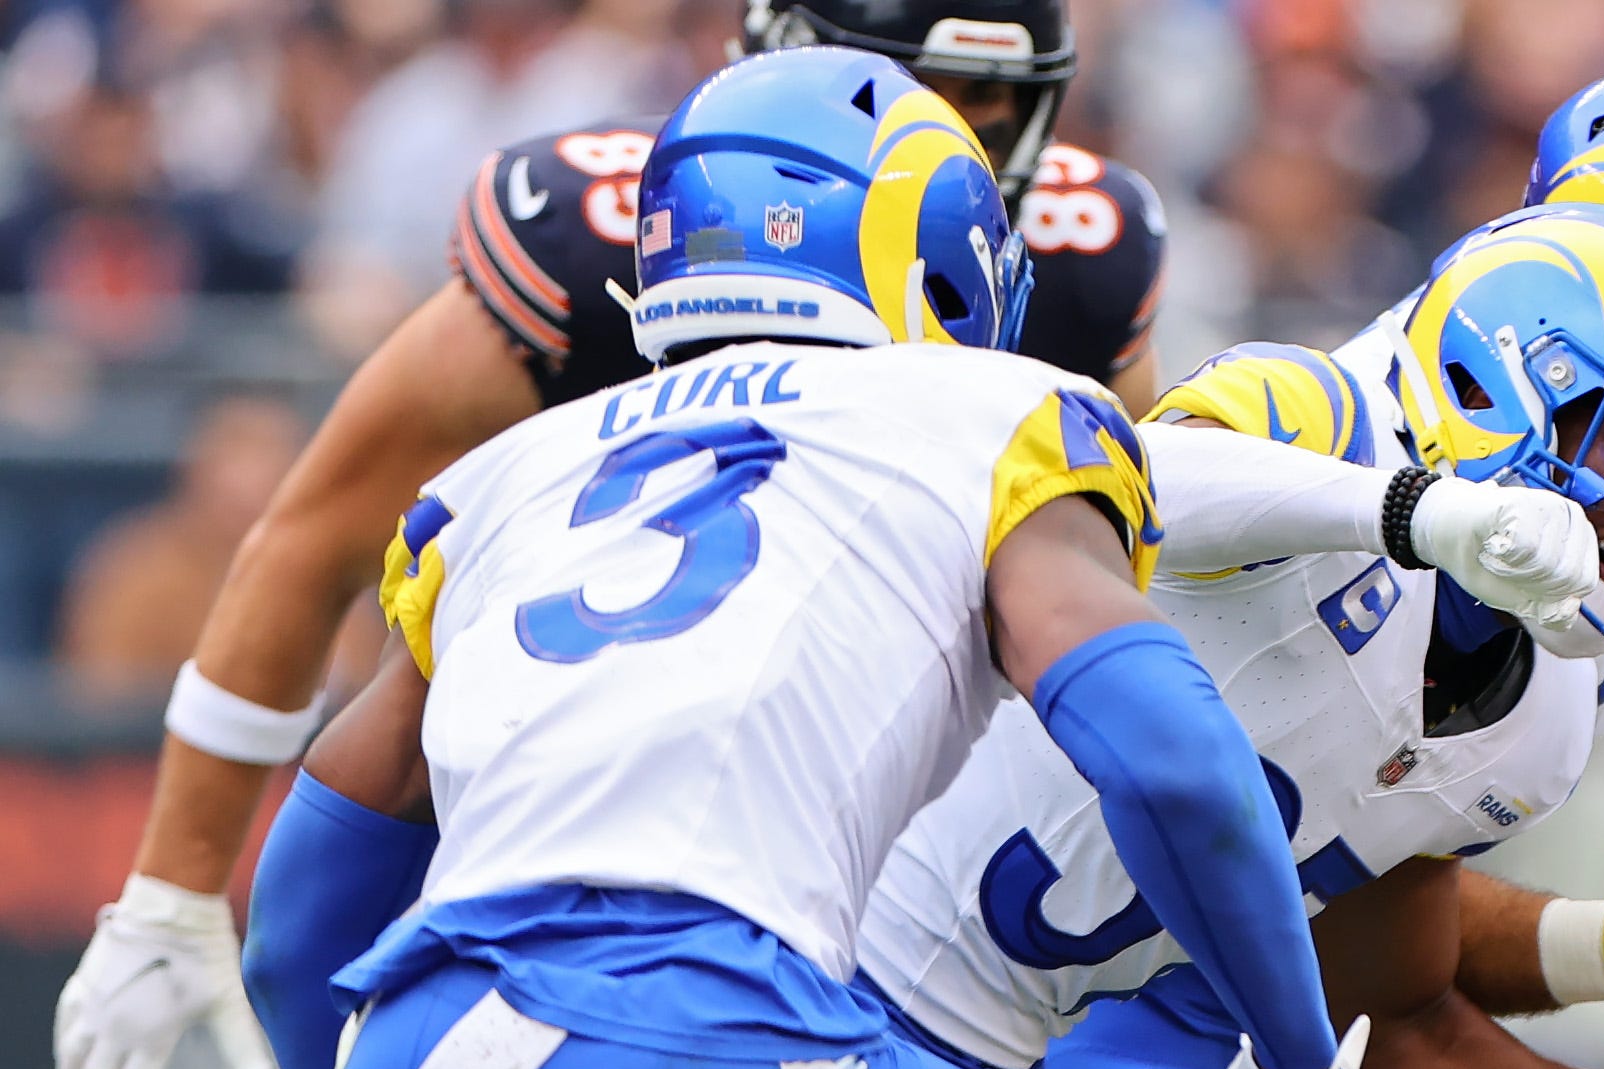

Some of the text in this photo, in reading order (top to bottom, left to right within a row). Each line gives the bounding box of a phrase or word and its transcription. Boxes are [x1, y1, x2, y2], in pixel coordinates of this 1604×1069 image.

[770, 221, 797, 248] NFL
[635, 298, 819, 325] LOS ANGELES
[598, 359, 801, 439] CURL
[514, 417, 787, 664] 3
[1342, 566, 1395, 633] C
[1476, 793, 1519, 827] RAMS
